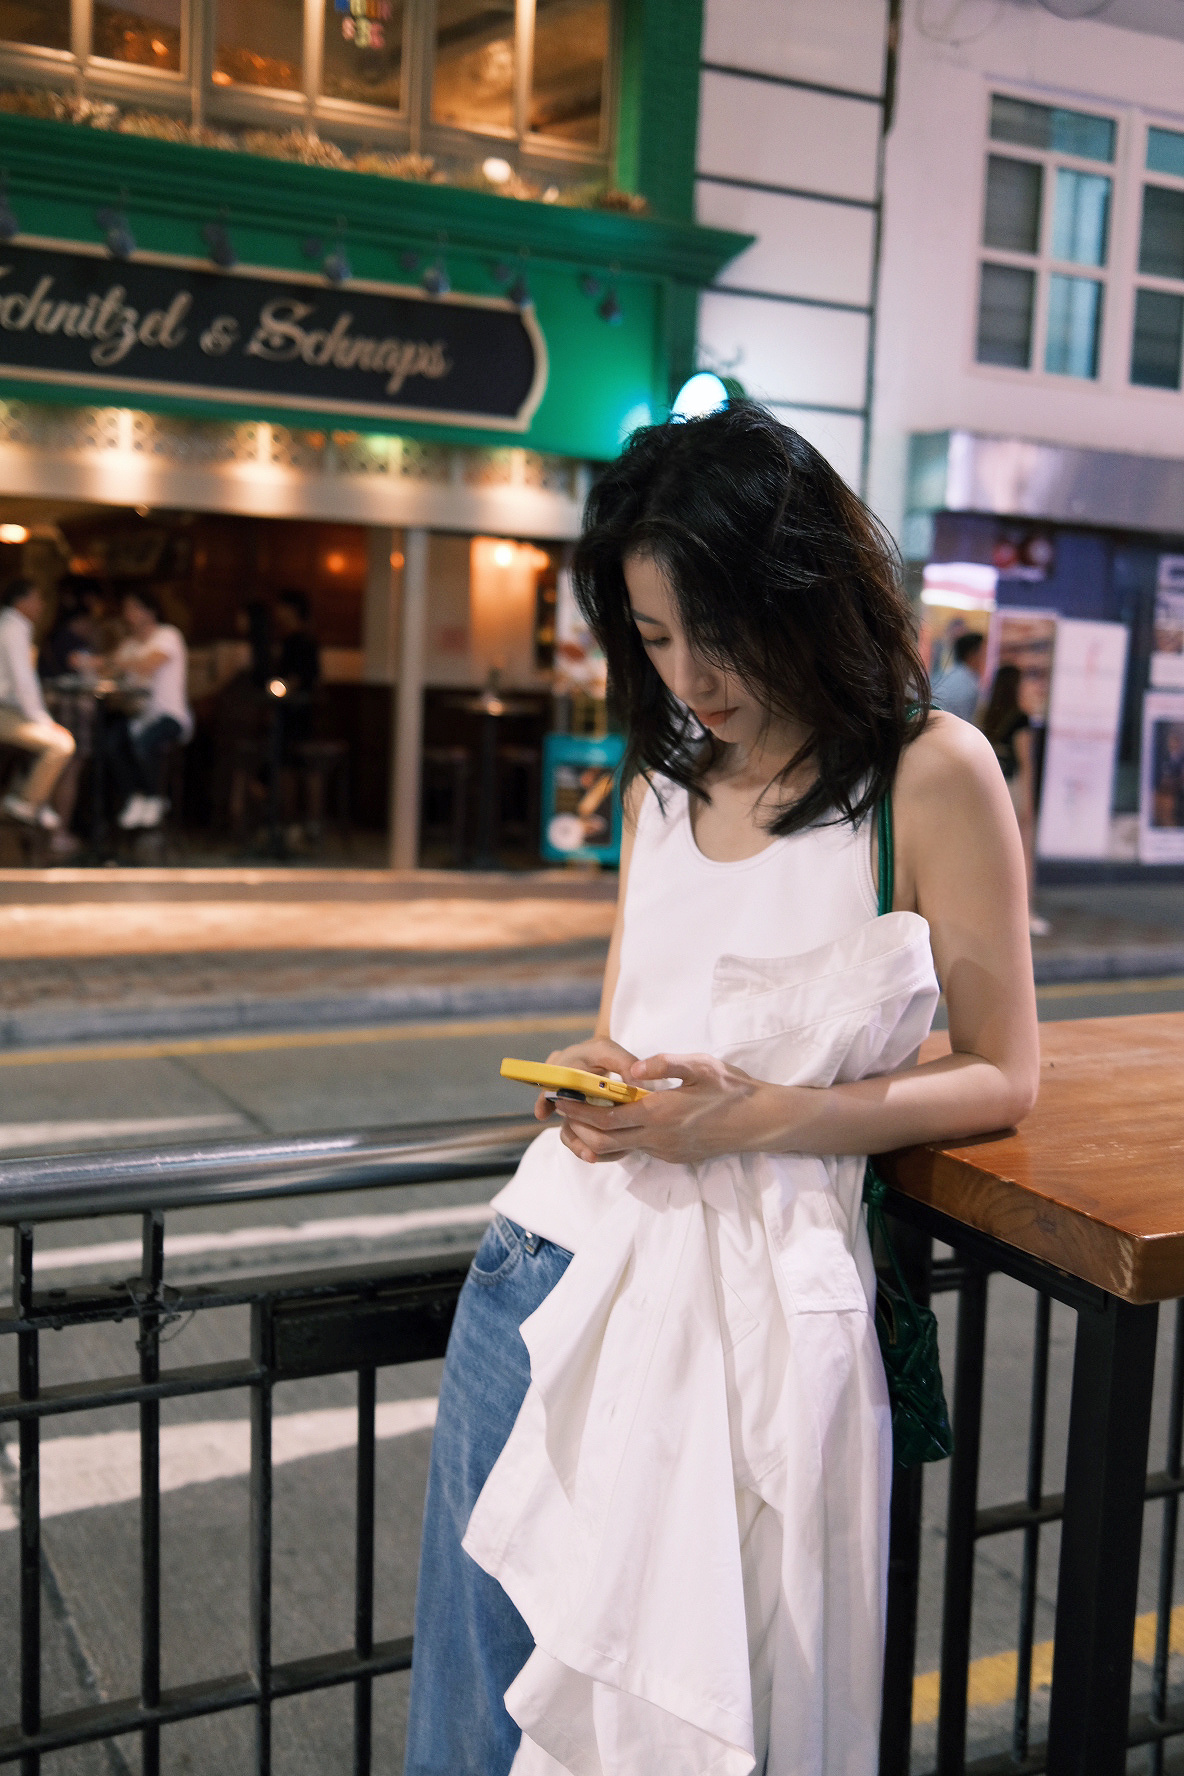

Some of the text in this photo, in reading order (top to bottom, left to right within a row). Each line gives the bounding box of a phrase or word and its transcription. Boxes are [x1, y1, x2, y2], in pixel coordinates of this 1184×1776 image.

[0, 265, 451, 395] chnitzel & Schnaps
